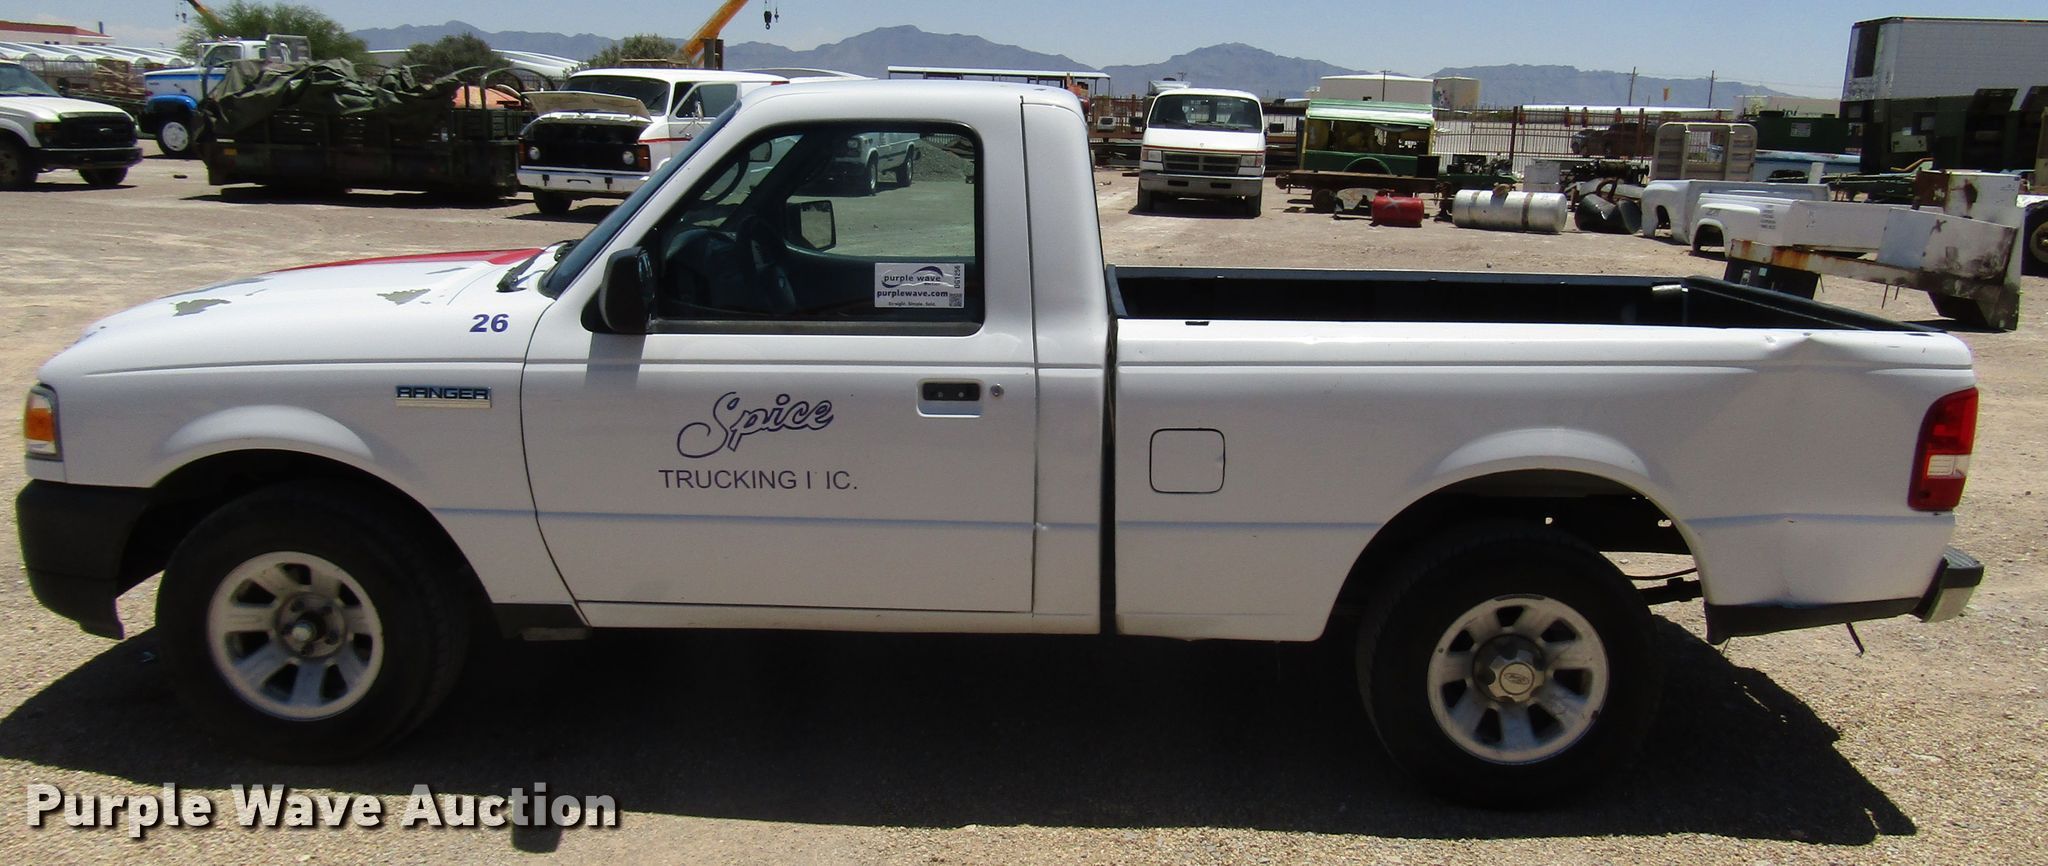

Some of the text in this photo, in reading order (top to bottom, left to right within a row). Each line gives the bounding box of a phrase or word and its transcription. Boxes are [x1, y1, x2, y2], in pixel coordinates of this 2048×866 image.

[884, 275, 914, 283] purple
[877, 289, 948, 298] purplewave.com
[469, 313, 510, 333] 26
[396, 386, 489, 400] RANGER
[677, 391, 834, 459] Spice
[658, 469, 797, 490] TRUCKING
